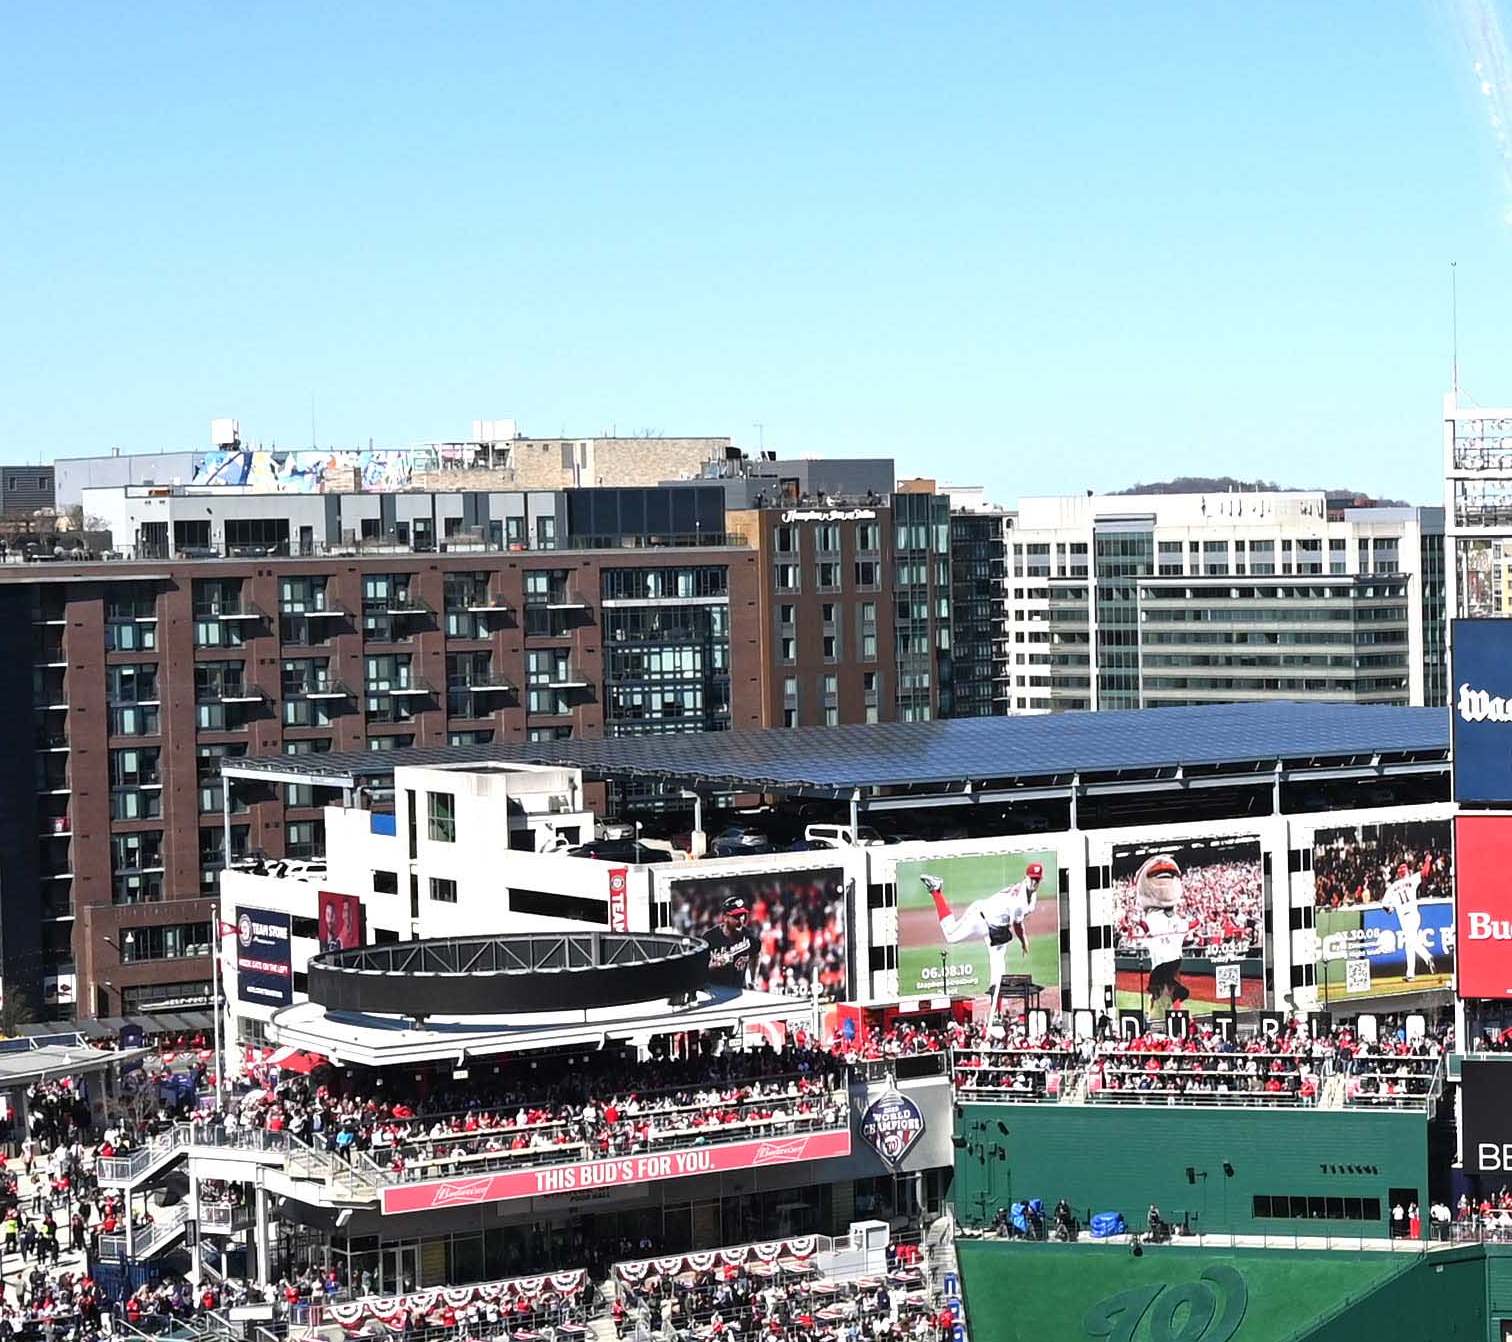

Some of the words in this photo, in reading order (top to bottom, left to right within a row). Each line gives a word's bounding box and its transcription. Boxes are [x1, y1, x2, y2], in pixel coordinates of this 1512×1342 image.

[921, 963, 974, 980] 06.08.10
[872, 1109, 911, 1122] WORLD
[863, 1118, 920, 1136] CHAMPIONS
[535, 1167, 577, 1192] THIS
[579, 1161, 635, 1188] BUD'S
[636, 1155, 672, 1179] FOR
[673, 1149, 716, 1175] YOU.
